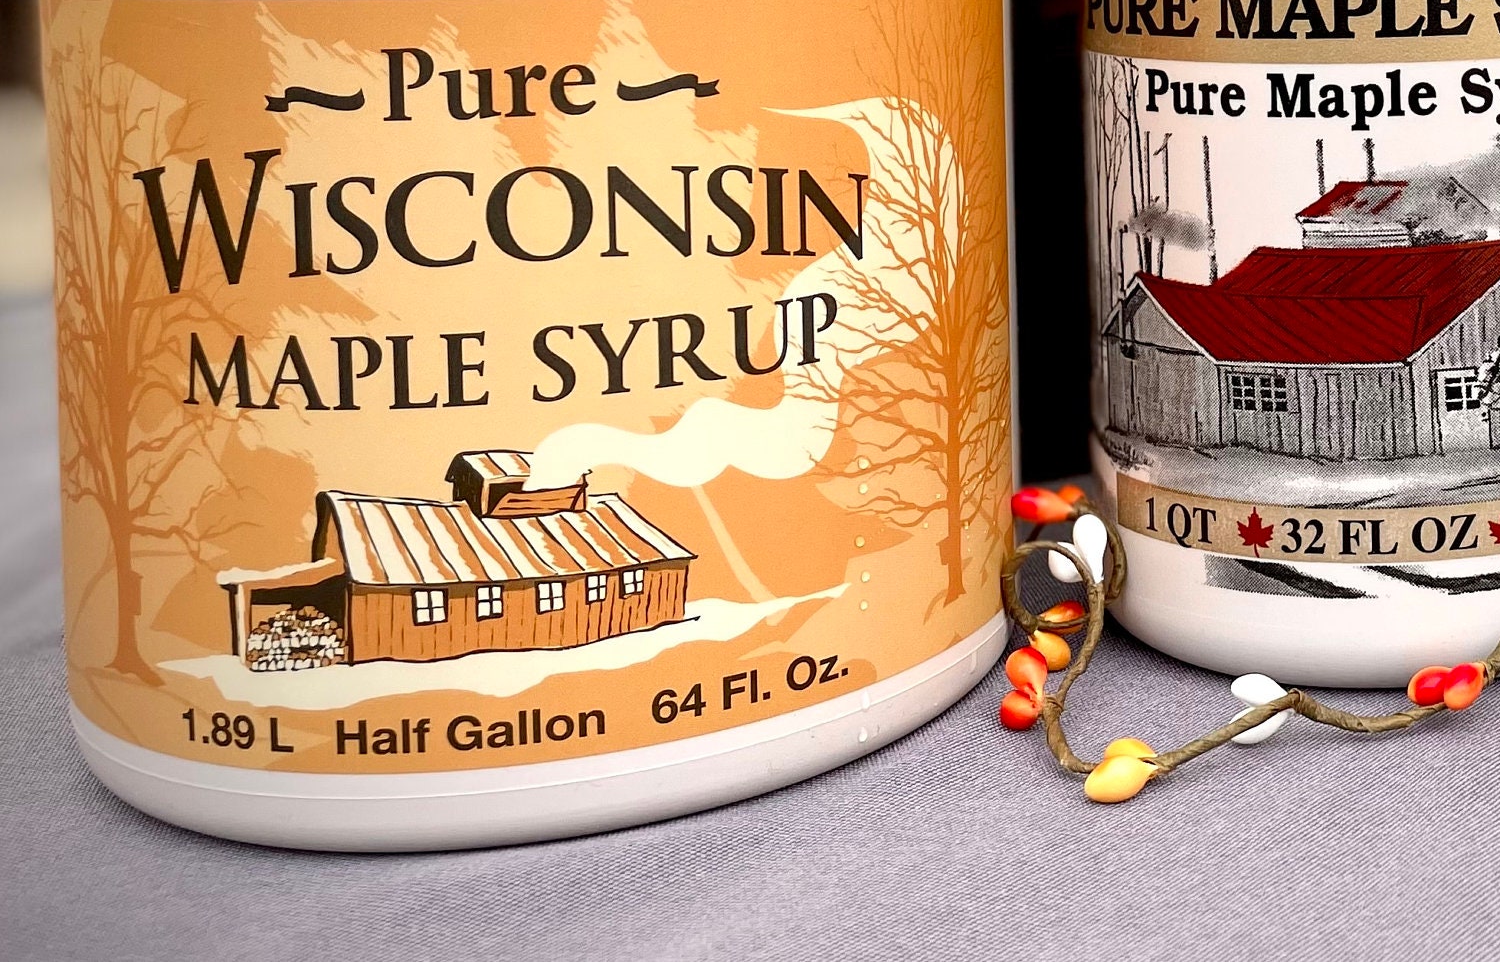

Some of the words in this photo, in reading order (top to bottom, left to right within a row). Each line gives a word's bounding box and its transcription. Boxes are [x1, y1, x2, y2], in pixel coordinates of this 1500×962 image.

[383, 47, 597, 122] Pure
[1145, 69, 1246, 116] Pure
[1267, 70, 1437, 130] Maple
[133, 149, 870, 293] WISCONSIN
[183, 332, 490, 411] MAPLE
[532, 292, 838, 402] SYRUP
[1145, 497, 1156, 531] 1
[1167, 503, 1216, 547] QT
[1280, 518, 1326, 554] 32
[1338, 519, 1398, 555] FL
[1412, 514, 1478, 552] OZ
[181, 709, 257, 750] 1.89
[271, 718, 294, 754] L
[336, 717, 429, 756] Half
[445, 707, 606, 751] Gallon
[651, 684, 706, 724] 64
[722, 670, 772, 713] Fl.
[785, 653, 849, 692] Oz.
